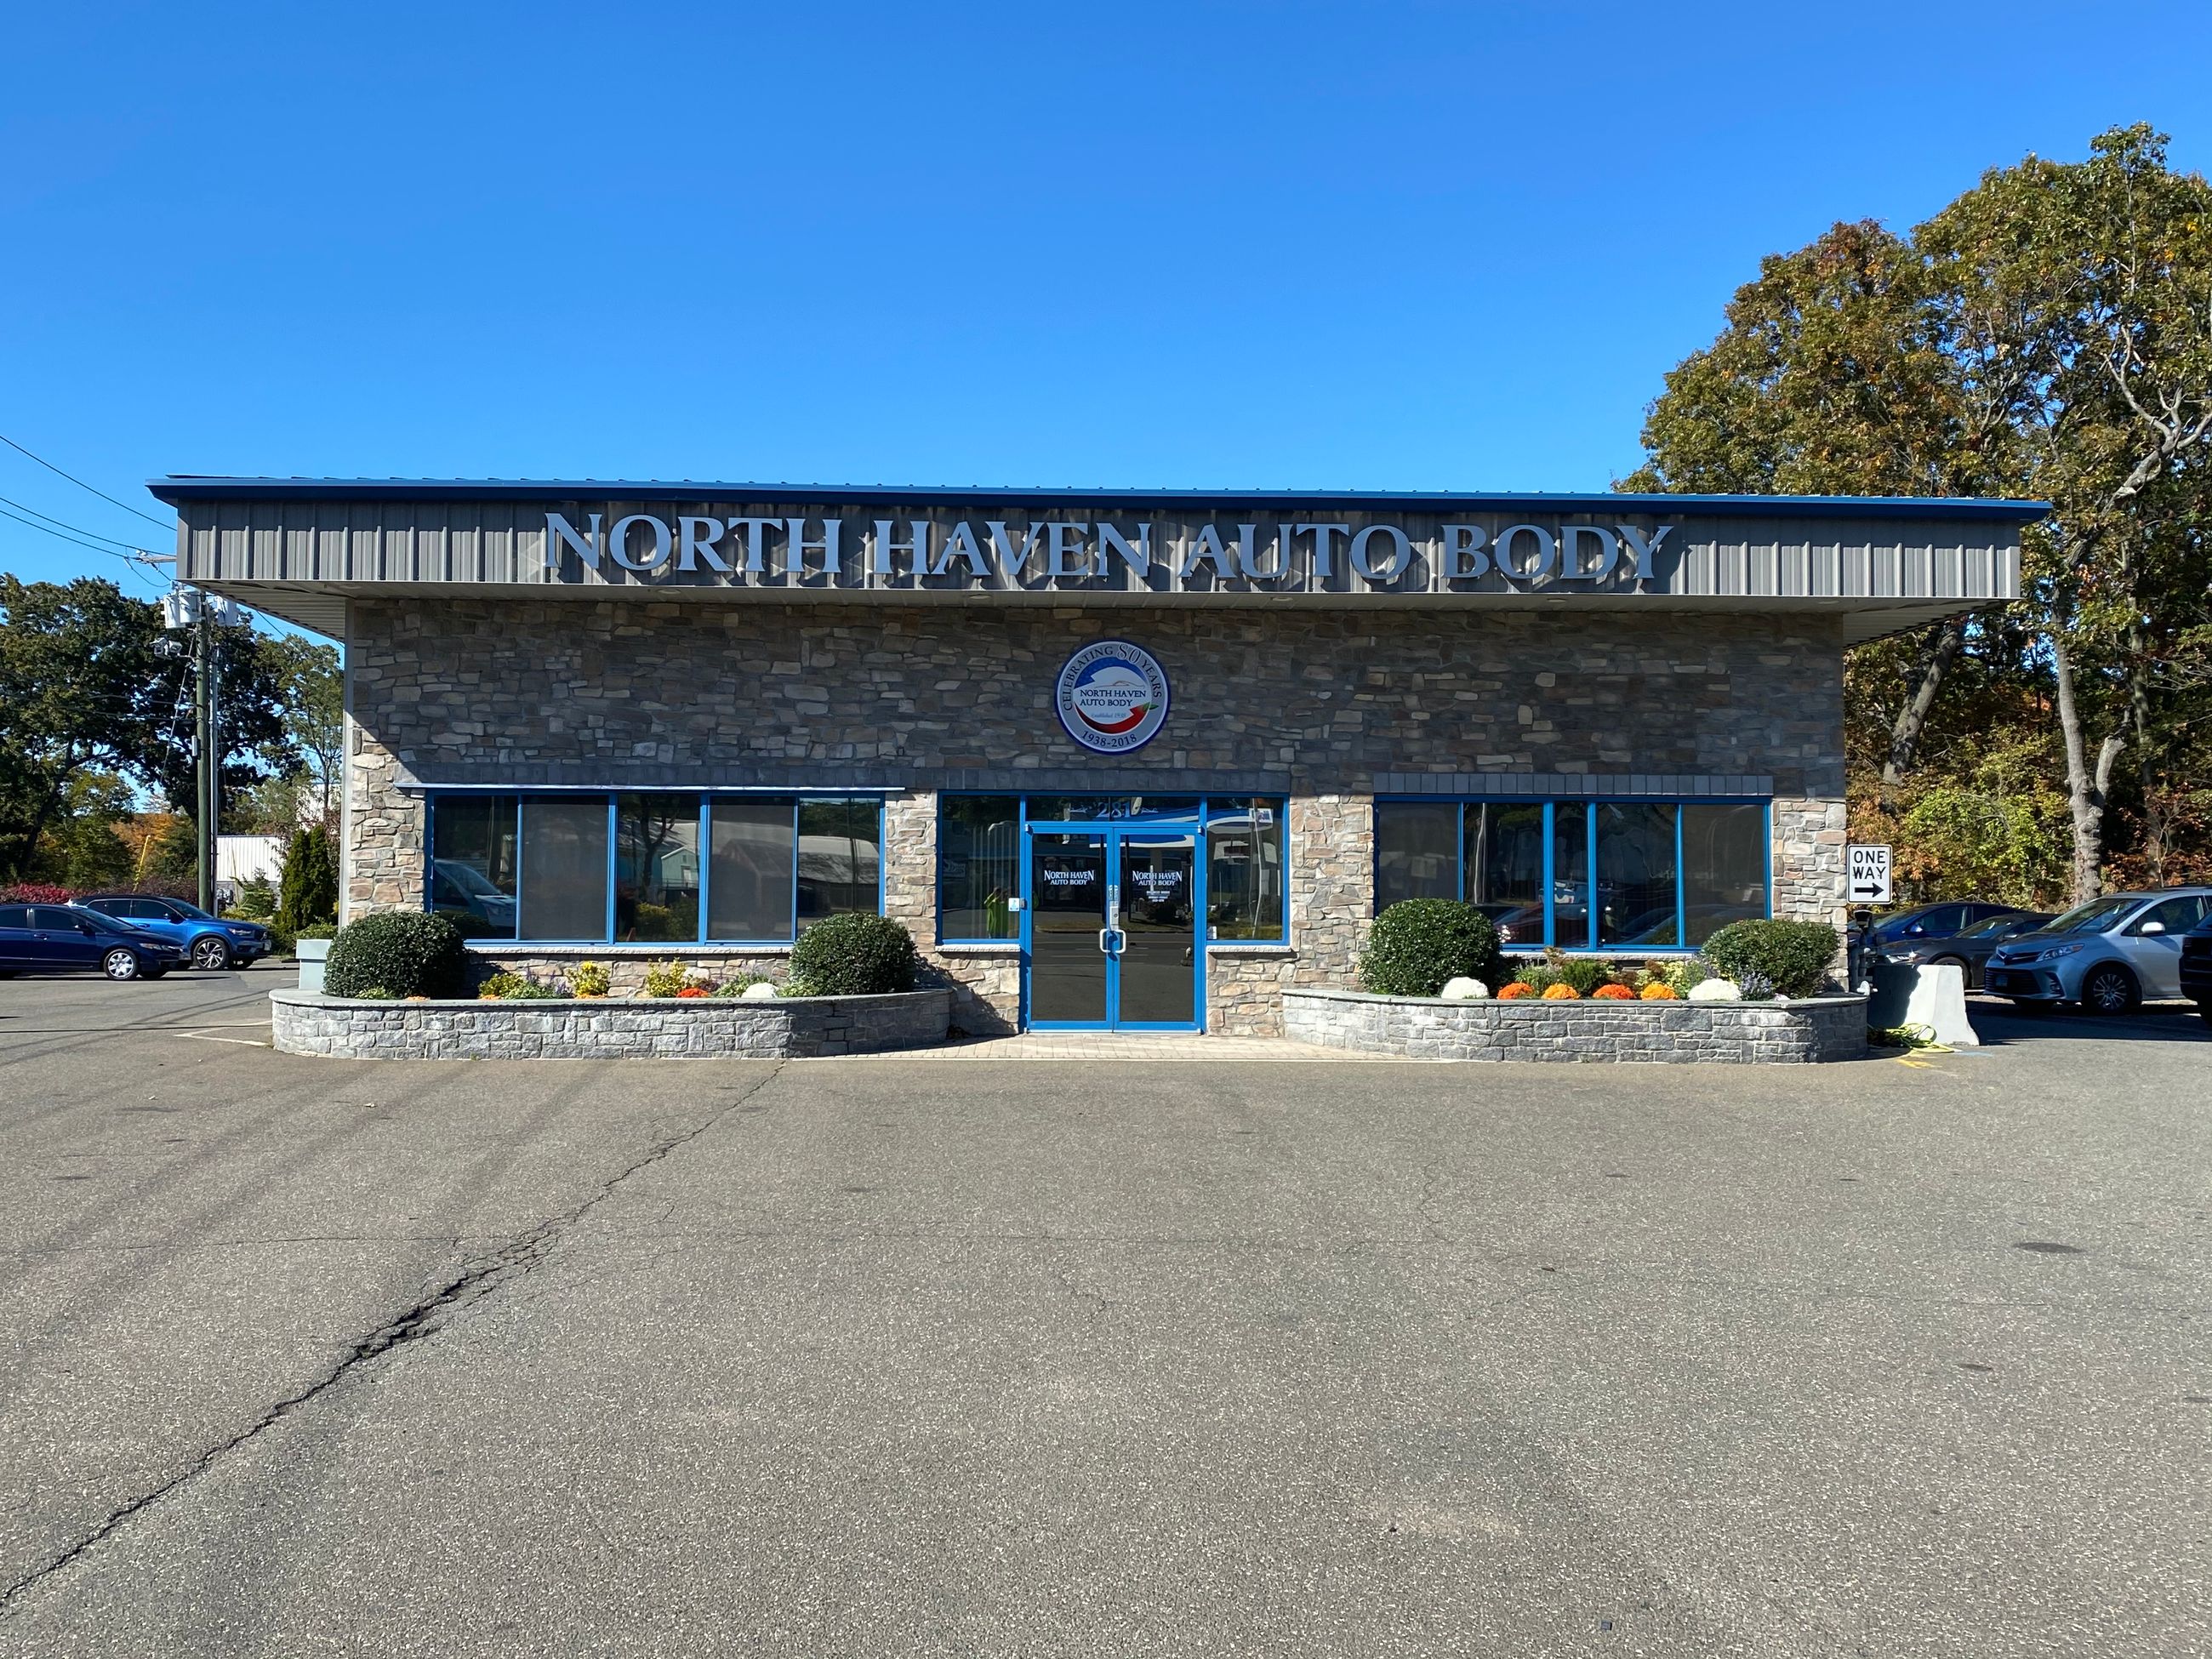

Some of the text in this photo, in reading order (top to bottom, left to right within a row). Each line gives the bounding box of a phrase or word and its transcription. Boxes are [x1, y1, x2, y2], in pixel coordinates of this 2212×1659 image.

[544, 512, 1675, 580] NORTH HAVEN AUTO BODY
[1063, 642, 1162, 711] CELEBRATING 80 YEARS
[1080, 689, 1112, 698] NORTH
[1108, 698, 1133, 707] BODY
[1081, 731, 1137, 748] 1938-2018
[1096, 801, 1131, 818] 281
[1854, 850, 1886, 864] ONE
[1044, 869, 1095, 881] NORTH HAVEN
[1132, 869, 1183, 882] NORTH HAVEN
[1852, 866, 1886, 880] WAY
